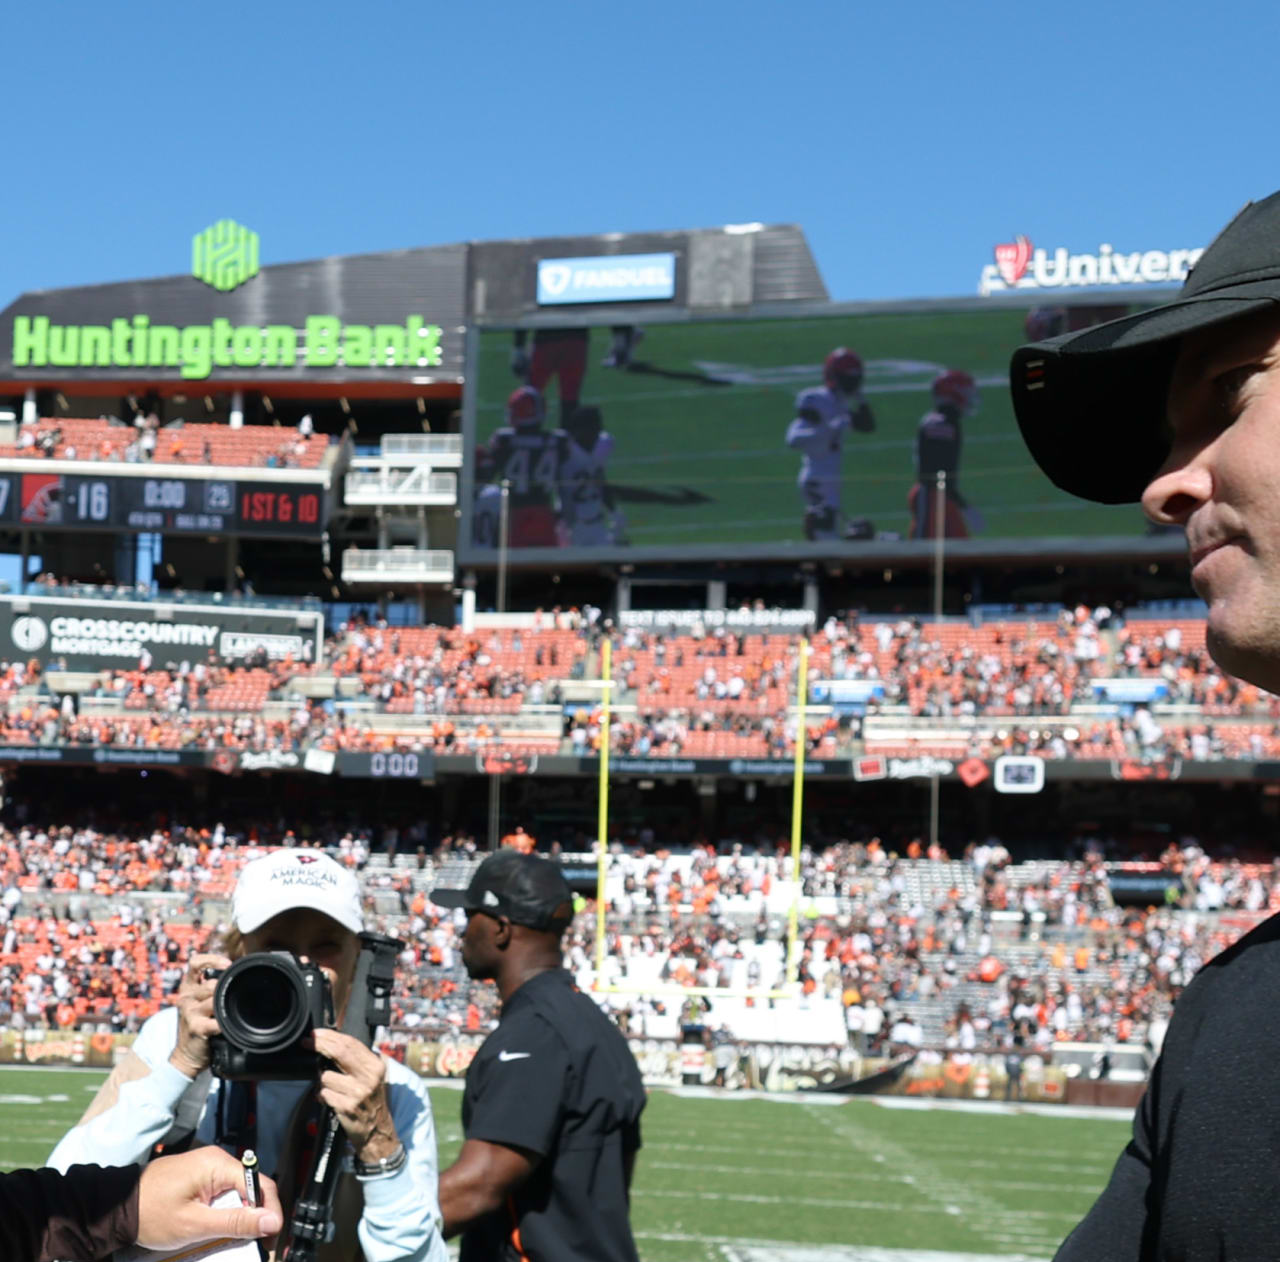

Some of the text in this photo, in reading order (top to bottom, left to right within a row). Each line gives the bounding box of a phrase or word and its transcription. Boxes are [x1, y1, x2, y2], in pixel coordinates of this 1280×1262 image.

[12, 313, 441, 379] Huntington Bank
[78, 482, 109, 520] 16
[242, 493, 276, 521] 1ST
[297, 494, 318, 523] 10
[50, 617, 220, 646] CROSSCOUNTRY
[51, 637, 143, 657] MORTGAGE
[271, 868, 338, 886] AMERICAN
[283, 877, 327, 890] MAGIC
